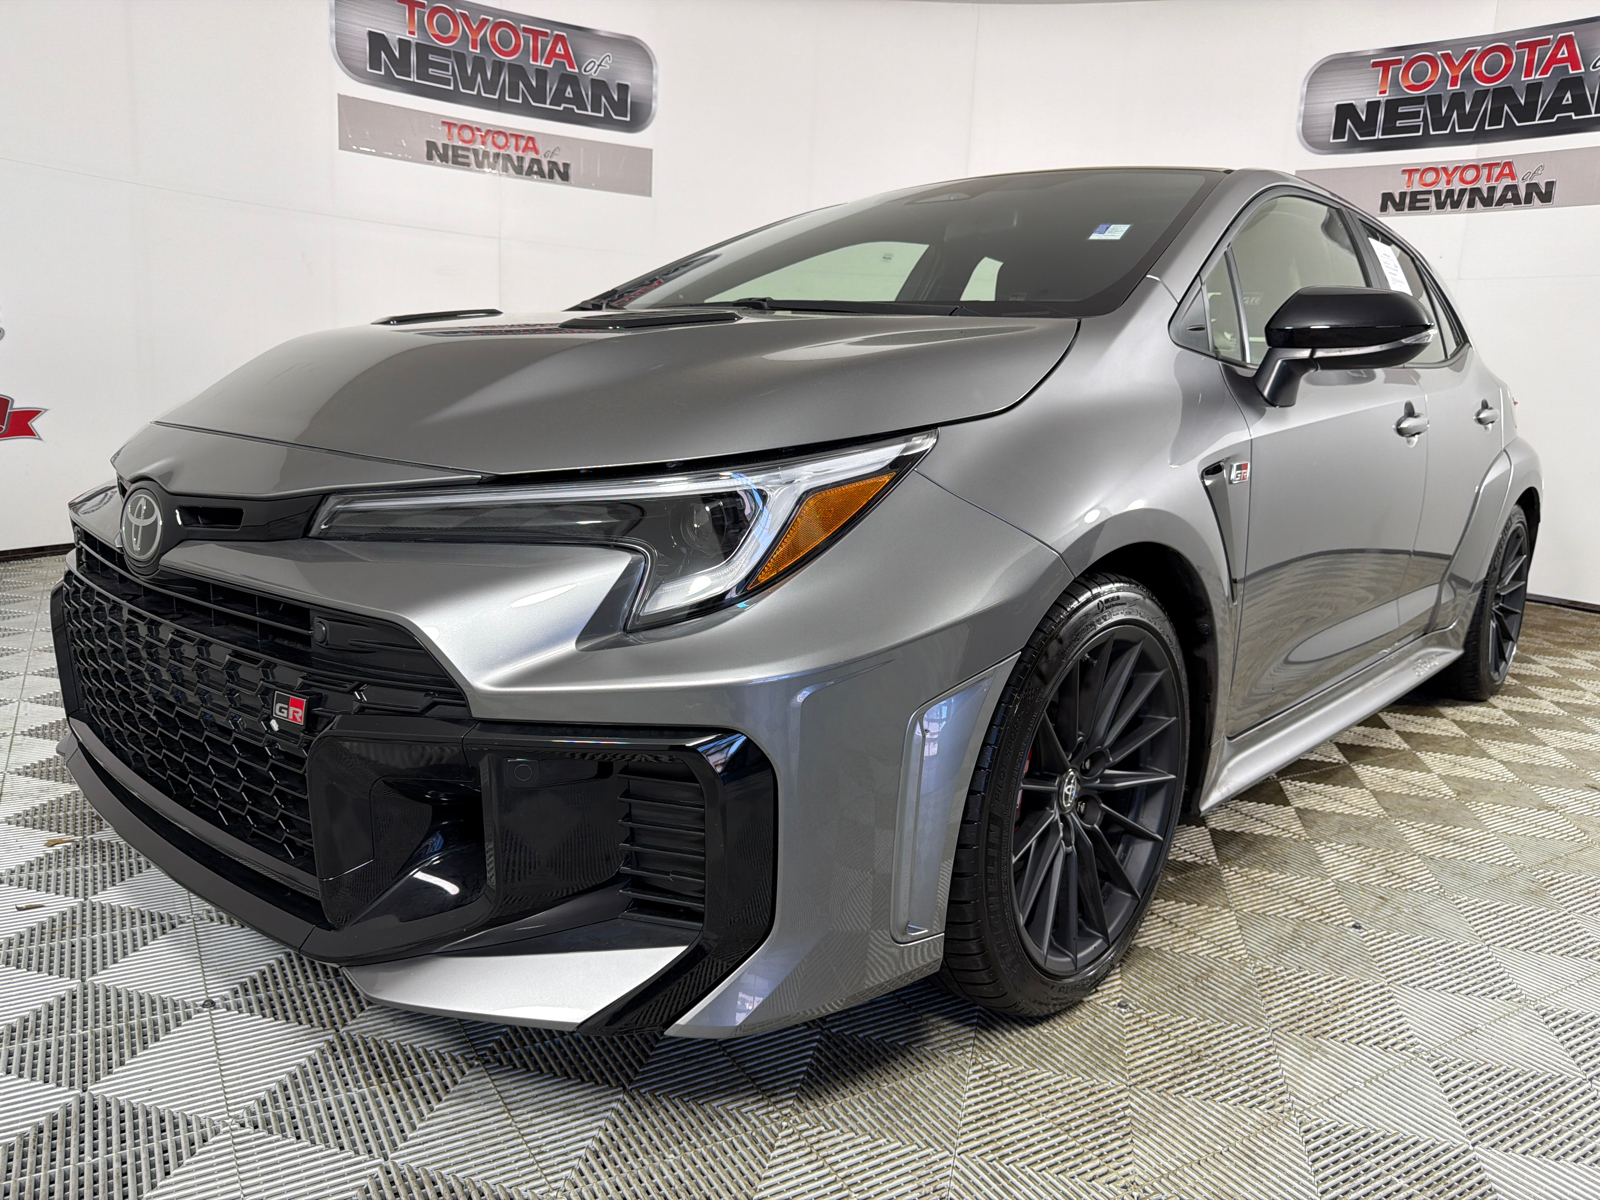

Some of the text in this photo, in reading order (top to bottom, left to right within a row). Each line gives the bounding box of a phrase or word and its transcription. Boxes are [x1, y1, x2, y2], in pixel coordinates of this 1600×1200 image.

[398, 0, 612, 75] TOYOTA of
[367, 29, 631, 121] NEWNAN
[1371, 32, 1585, 96] TOYOTA
[1330, 76, 1600, 142] NEWNA
[441, 120, 560, 159] TOYOTA of
[425, 141, 571, 182] NEWNAN
[1401, 160, 1544, 189] TOYOTA of
[1379, 180, 1556, 213] NEWNAN
[275, 702, 303, 722] GR
